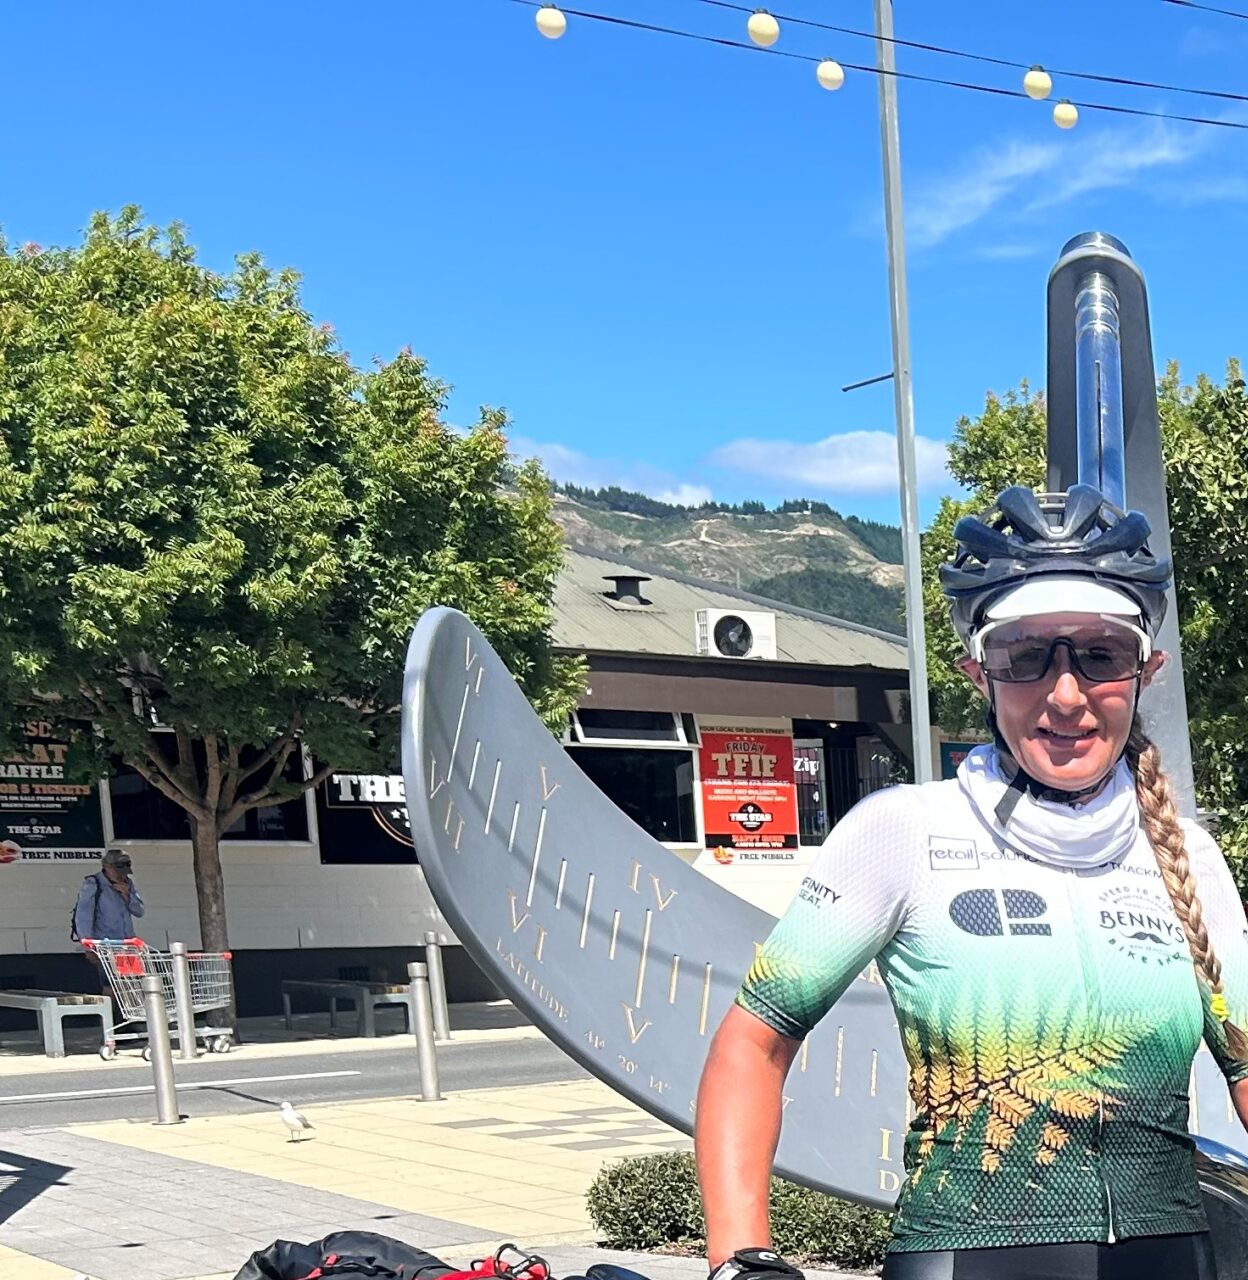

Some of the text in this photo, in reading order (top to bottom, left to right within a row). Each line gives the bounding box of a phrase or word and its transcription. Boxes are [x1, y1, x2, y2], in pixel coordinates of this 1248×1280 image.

[726, 741, 766, 753] FRIDAY
[32, 784, 91, 795] TICKETS
[333, 775, 406, 802] THE
[7, 826, 62, 834] THE STAR
[22, 852, 102, 860] FREE NIBBLES
[929, 847, 975, 861] retail
[1099, 910, 1185, 944] BENNYS
[496, 936, 569, 1023] LATITUDE
